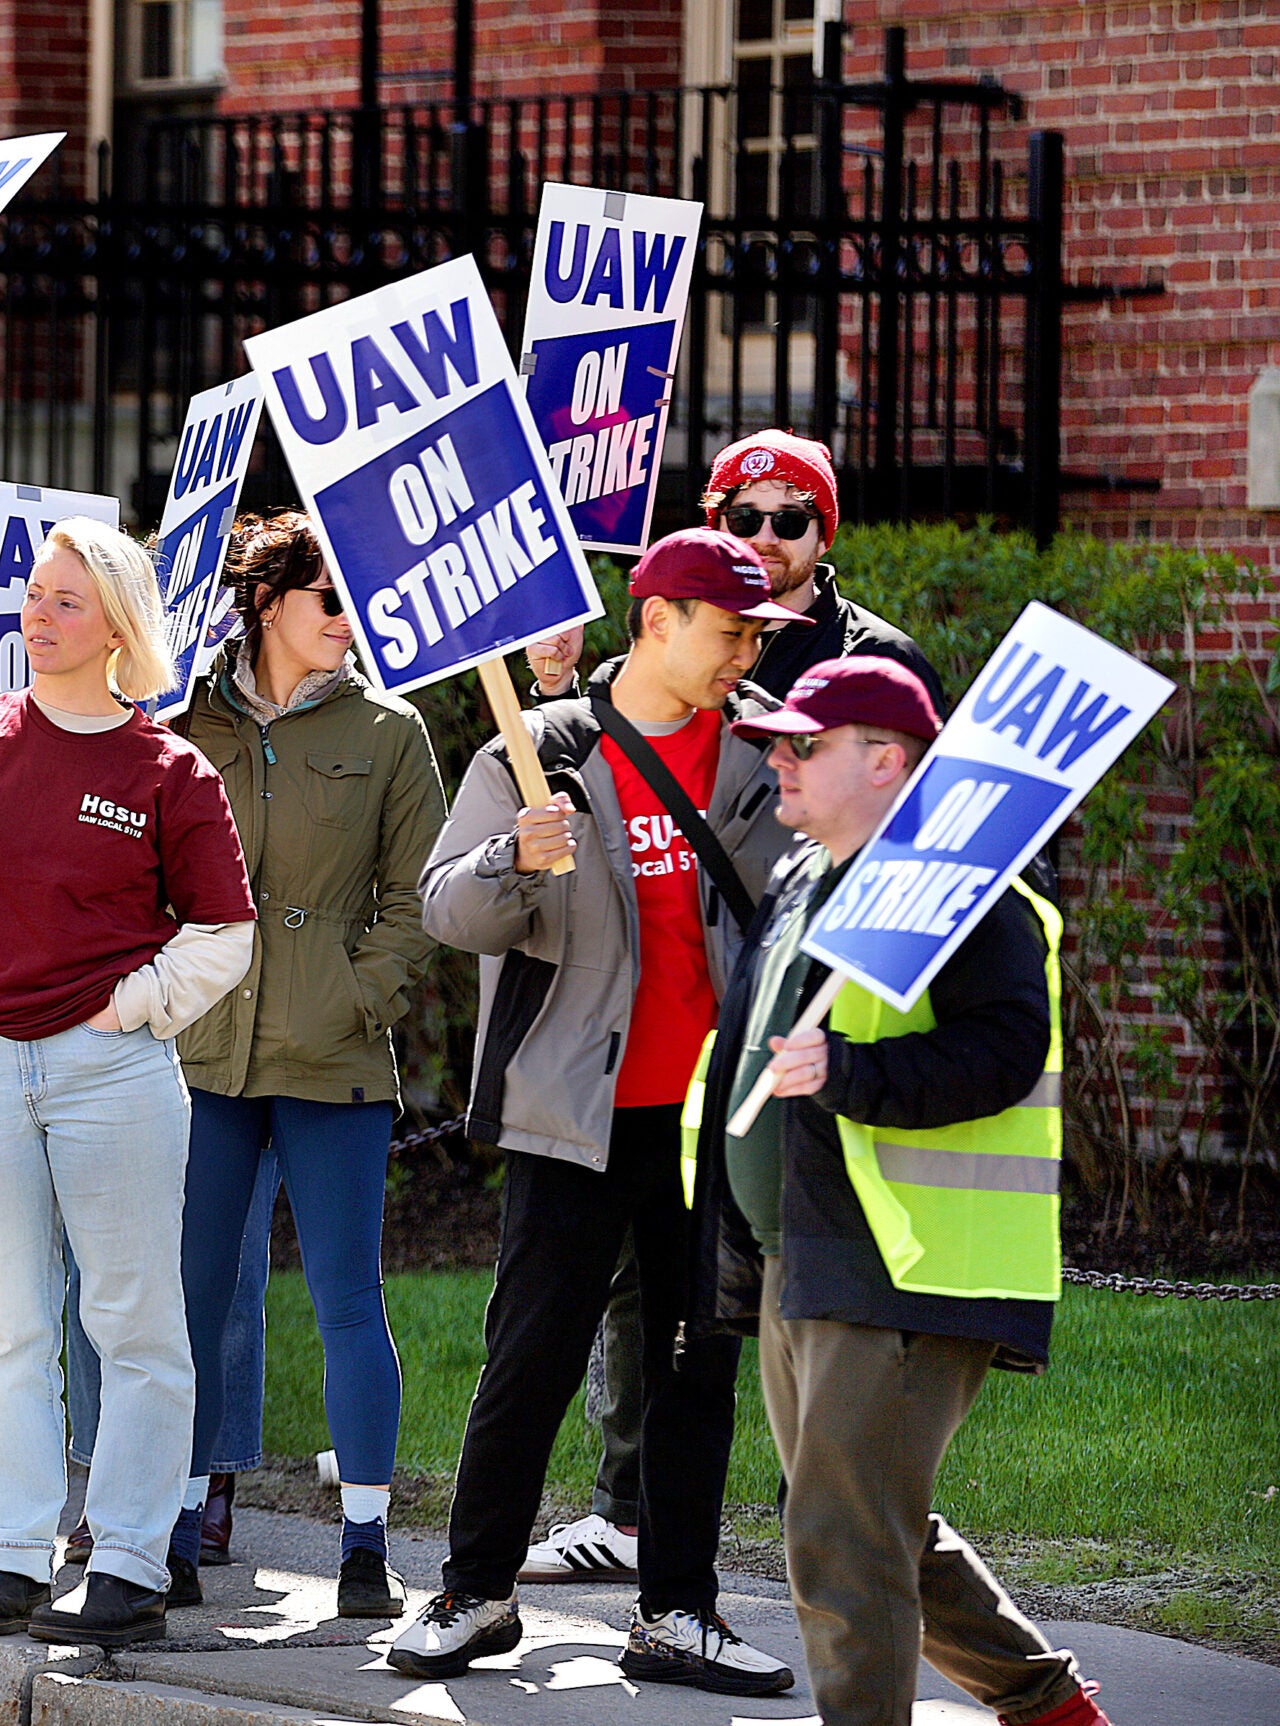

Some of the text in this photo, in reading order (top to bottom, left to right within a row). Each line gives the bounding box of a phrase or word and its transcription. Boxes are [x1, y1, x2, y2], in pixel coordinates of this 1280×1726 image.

[543, 219, 688, 314] UAW
[271, 296, 479, 446] UAW
[569, 342, 630, 425] ON
[174, 397, 257, 500] UAW
[388, 433, 476, 546] ON
[548, 413, 656, 507] TRIKE
[166, 513, 209, 606] ON
[368, 479, 559, 670] STRIKE
[970, 641, 1133, 773] UAW
[78, 814, 143, 838] UAW LOCAL 5118
[81, 793, 147, 827] HGSU
[913, 778, 1012, 852] ON
[631, 850, 699, 878] ocal 51
[824, 859, 999, 938] STRIKE
